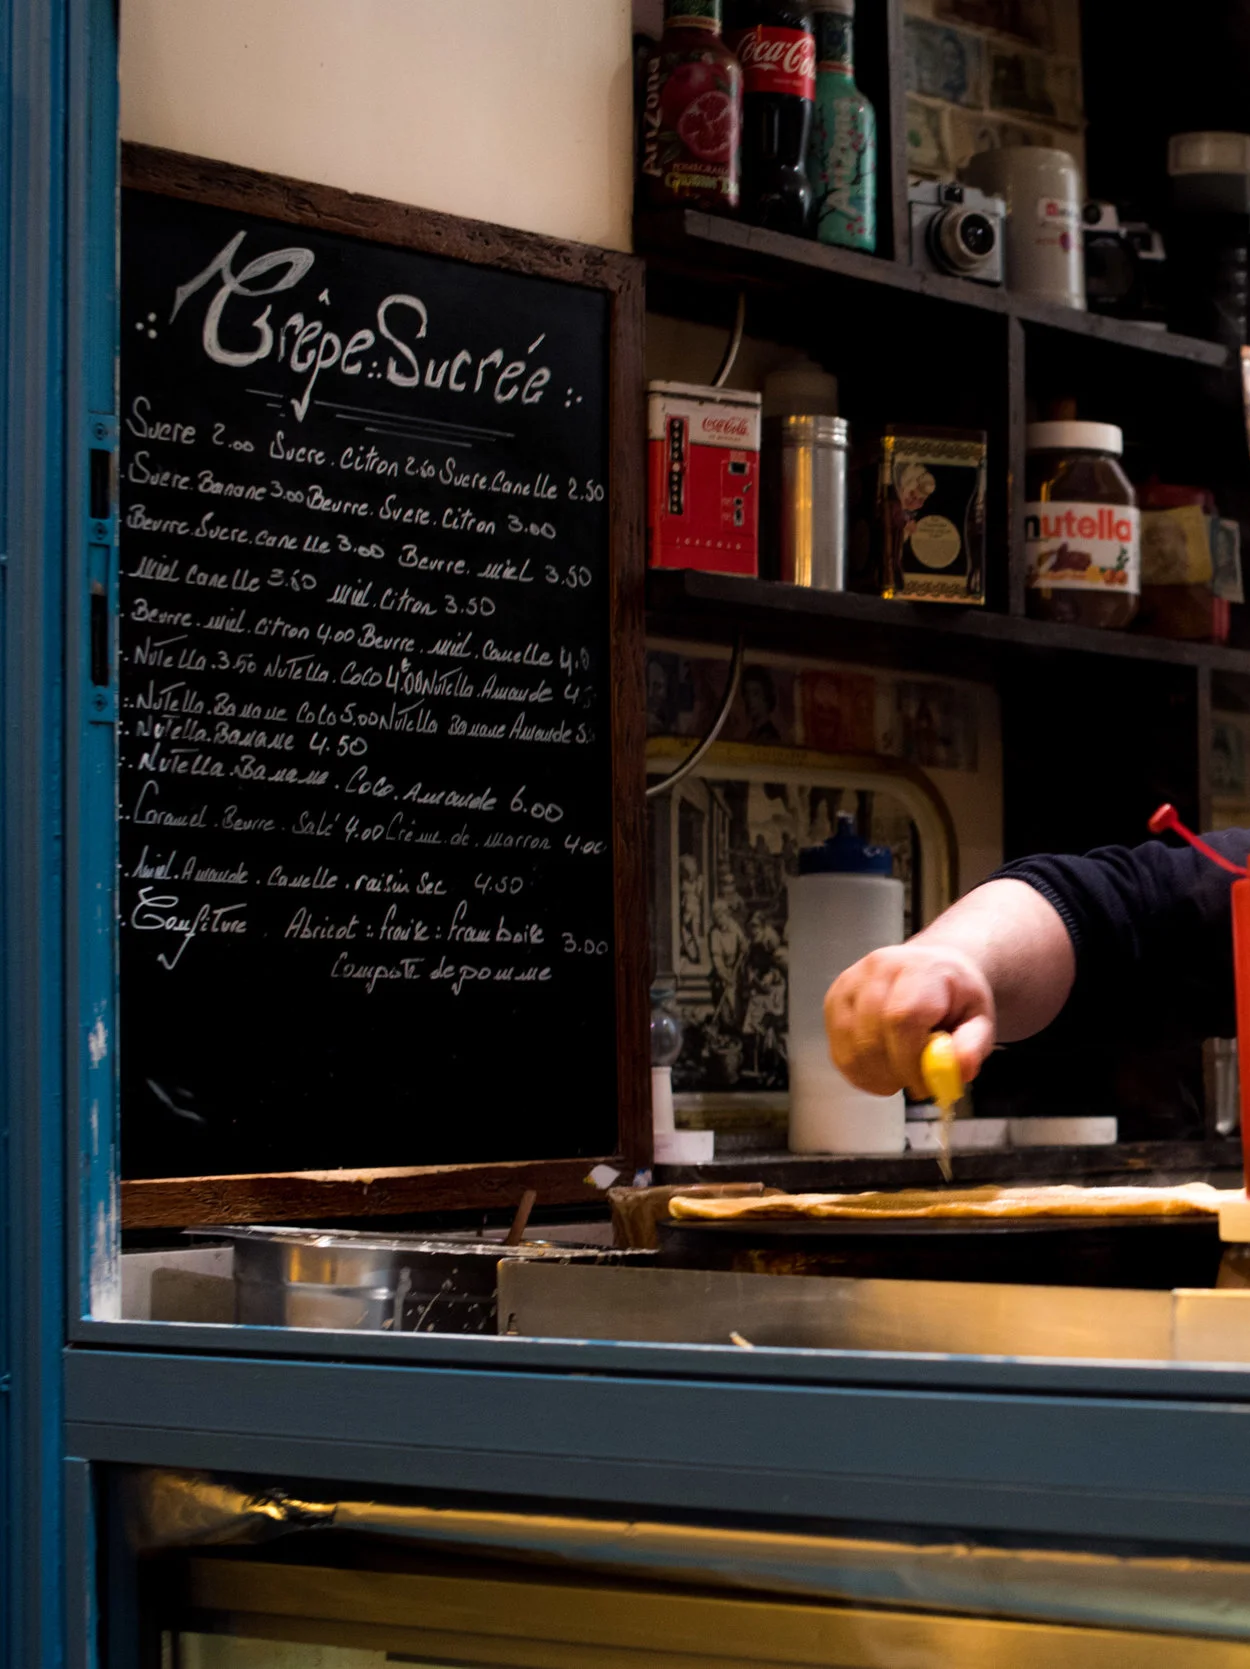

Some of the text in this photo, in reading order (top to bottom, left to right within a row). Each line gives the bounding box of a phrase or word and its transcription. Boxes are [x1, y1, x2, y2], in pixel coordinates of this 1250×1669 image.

[376, 293, 551, 406] Sucrée
[125, 396, 197, 444] Sucre
[212, 422, 255, 452] 2.00
[340, 445, 399, 478] Citron
[568, 476, 605, 501] 2.50
[442, 507, 496, 535] Citron
[507, 514, 557, 540] 3.00
[1025, 508, 1131, 542] nutella
[544, 564, 593, 588] 3.50
[379, 587, 438, 616] Citron
[444, 594, 496, 618] 3.50
[316, 623, 356, 646] 4.00
[309, 731, 369, 758] 4.50
[509, 784, 565, 823] 6.00
[473, 872, 524, 896] 4.50
[284, 906, 360, 941] Abricot
[560, 931, 609, 955] 3.00
